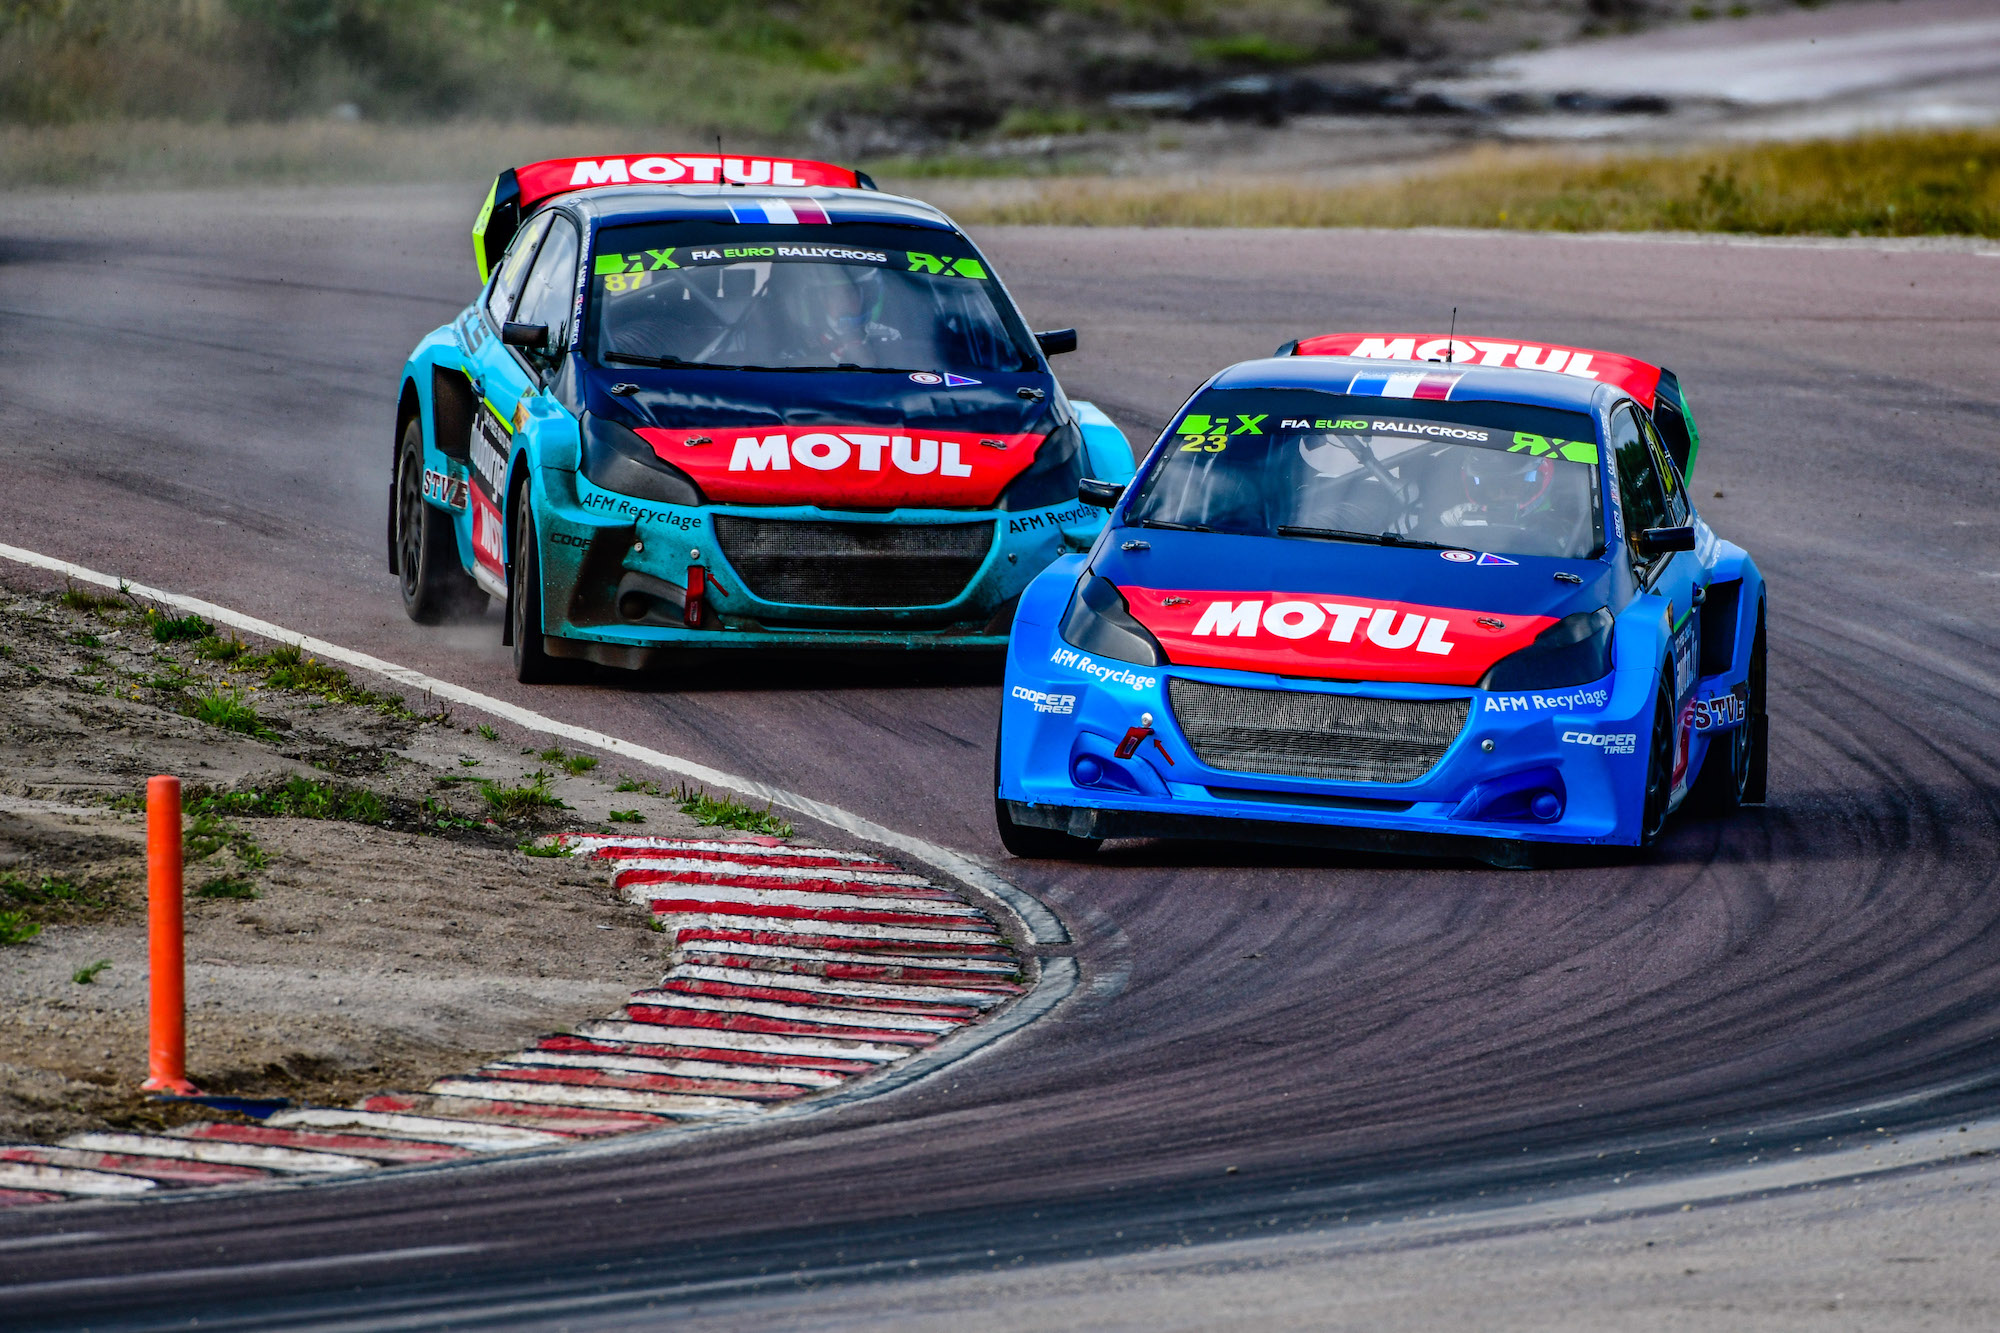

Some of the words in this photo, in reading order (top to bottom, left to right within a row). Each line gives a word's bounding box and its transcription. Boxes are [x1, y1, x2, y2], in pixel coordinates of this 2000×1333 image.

[568, 158, 806, 186] MOTUL
[691, 249, 721, 261] FIA
[724, 247, 775, 258] EURO
[778, 247, 887, 262] RALLYCROSS
[604, 271, 646, 292] 87
[1346, 337, 1600, 379] MOTUL
[1280, 419, 1310, 430] FIA
[1314, 419, 1369, 430] EURO
[1371, 420, 1488, 442] RALLYCROSS
[1180, 434, 1229, 453] 23
[728, 433, 973, 478] MOTUL
[581, 492, 616, 511] AFM
[617, 500, 702, 531] Recyclage
[1009, 514, 1044, 534] AFM
[1191, 600, 1455, 656] MOTUL
[1050, 647, 1080, 668] AFM
[1076, 656, 1157, 692] Recyclage
[1011, 685, 1077, 708] COOPER
[1484, 695, 1529, 713] AFM
[1532, 688, 1608, 710] Recyclage
[1033, 702, 1074, 715] TIRES
[1561, 731, 1637, 746] COOPER
[1603, 745, 1636, 755] TIRES
